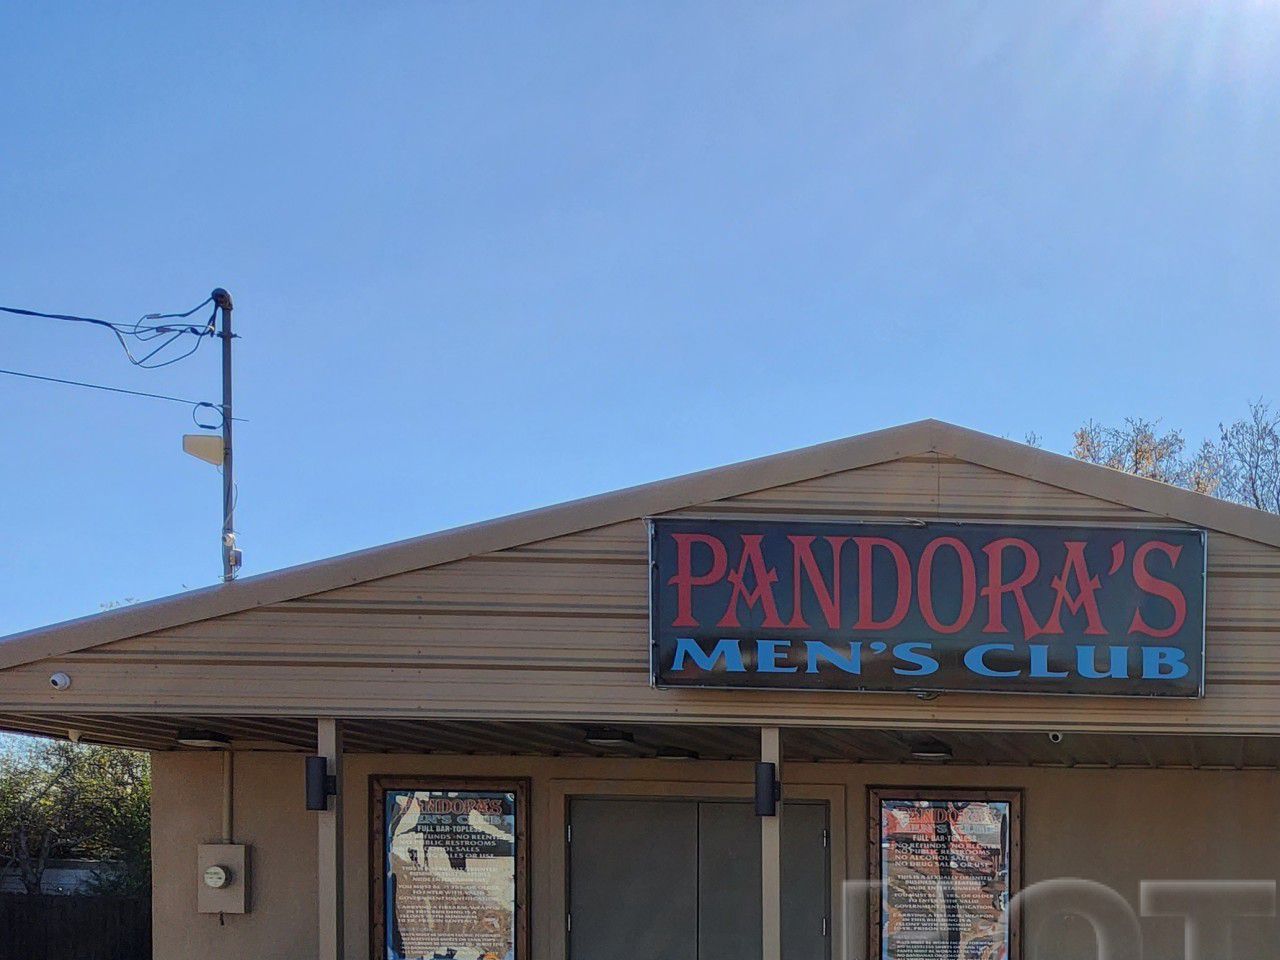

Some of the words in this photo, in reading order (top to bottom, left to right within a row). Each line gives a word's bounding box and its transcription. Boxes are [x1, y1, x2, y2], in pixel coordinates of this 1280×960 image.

[666, 532, 1188, 641] PANDORA'S
[670, 637, 940, 676] MEN'S
[964, 643, 1190, 680] CLUB
[912, 834, 930, 842] FULL
